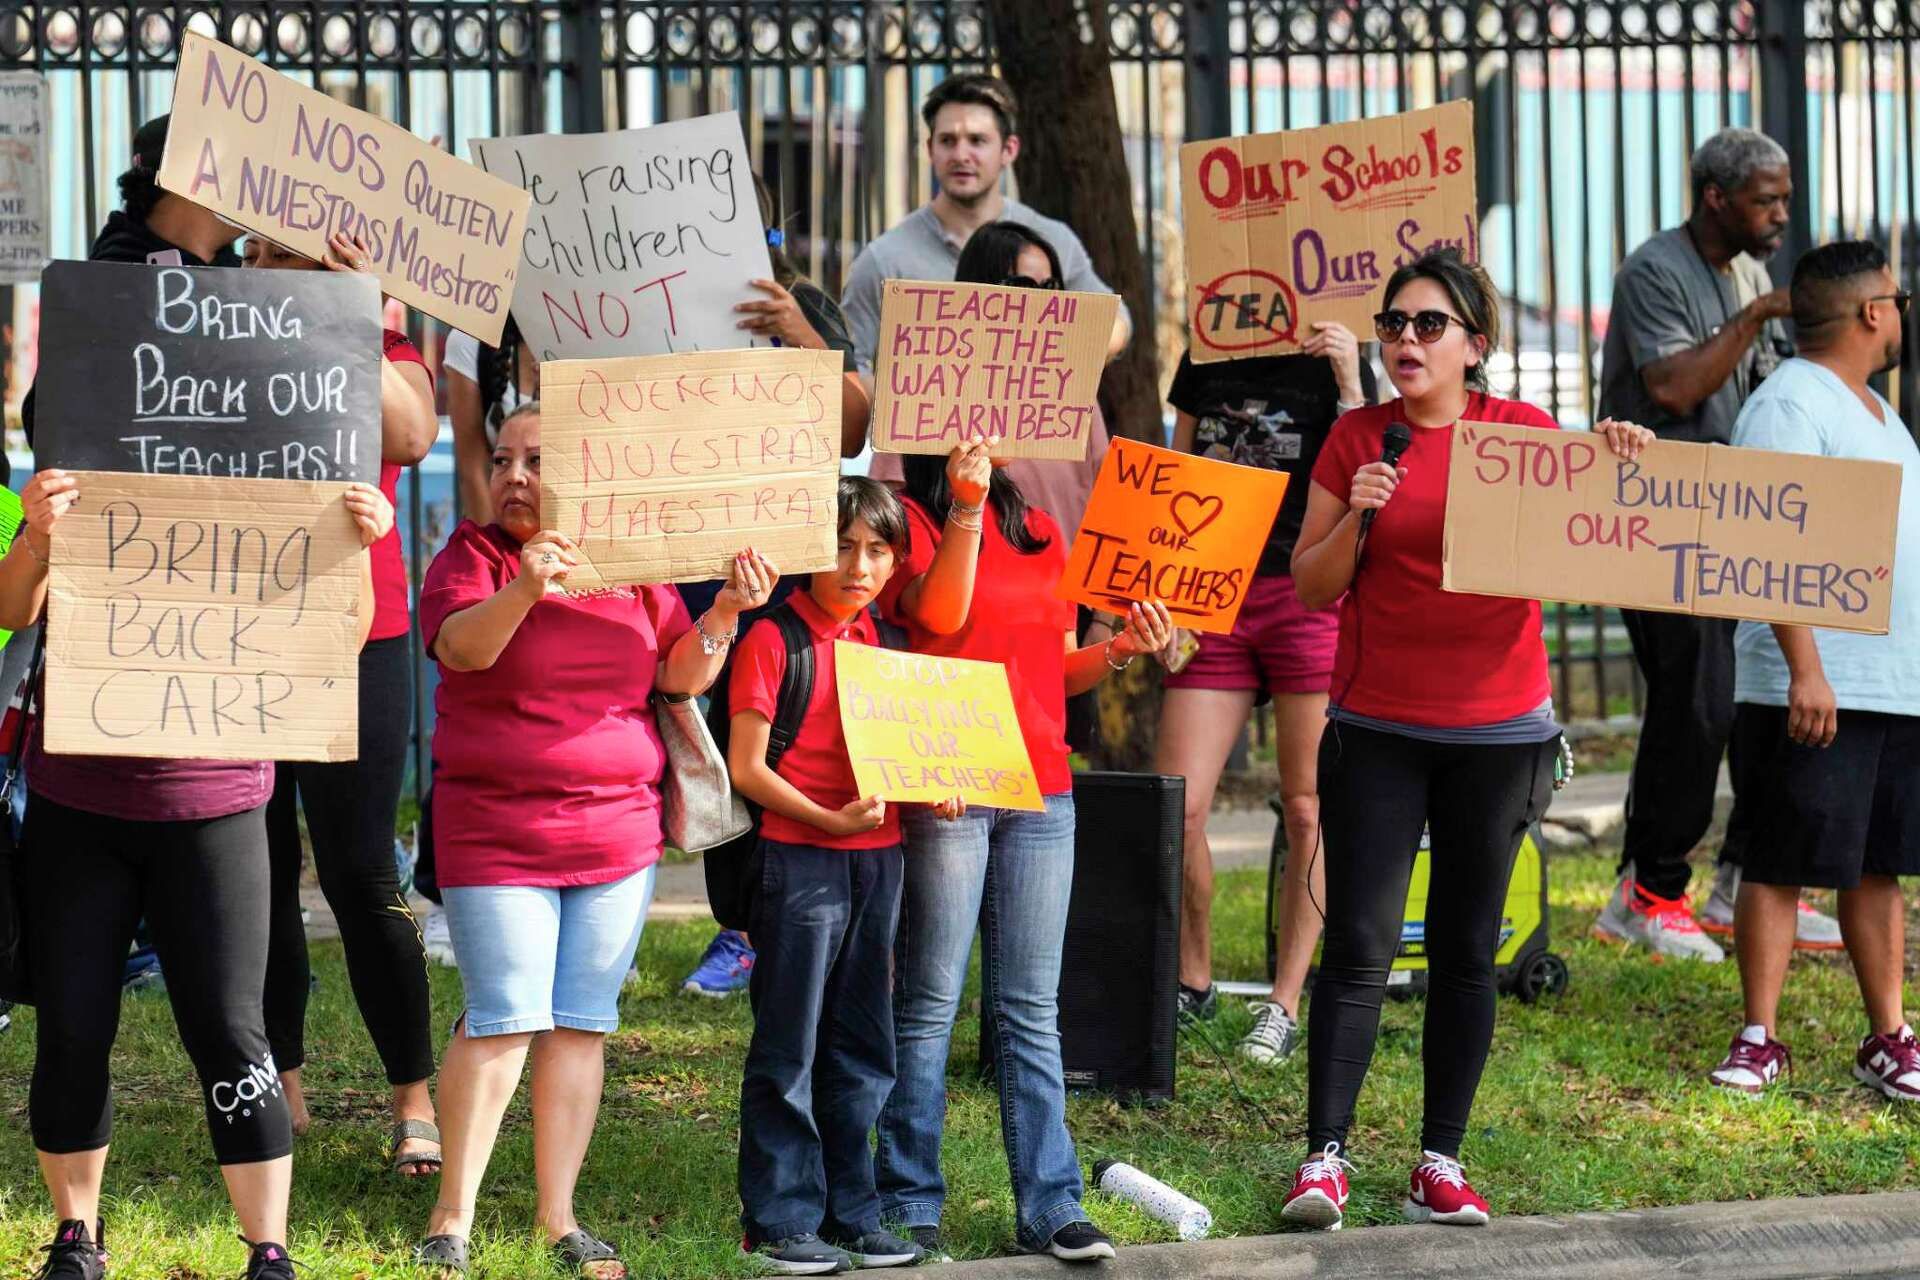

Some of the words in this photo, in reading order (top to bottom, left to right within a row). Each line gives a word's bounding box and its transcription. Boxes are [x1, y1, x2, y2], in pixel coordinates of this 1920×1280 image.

[292, 104, 385, 192] NOS
[404, 160, 513, 247] QUITEN
[578, 149, 736, 222] raising
[1320, 127, 1463, 202] Schools
[190, 138, 222, 200] A
[237, 157, 387, 264] NUESTRAS
[522, 205, 731, 277] children
[156, 268, 302, 340] BRING
[543, 270, 686, 343] NOT
[1202, 291, 1291, 332] TEA
[133, 342, 248, 416] BACK
[267, 366, 348, 417] OUR
[893, 324, 975, 358] KIDS
[985, 327, 1065, 364] THE
[578, 370, 825, 423] QUEREMOS
[891, 362, 970, 397] WAY
[982, 364, 1073, 400] THEY
[119, 429, 357, 480] TEACHERS!!
[890, 401, 1008, 441] LEARN
[581, 427, 833, 488] NUESTRAS
[1462, 427, 1596, 493] "STOP
[1613, 461, 1808, 534] BULLYING
[1081, 528, 1243, 609] TEACHERS
[1566, 513, 1658, 551] OUR
[1658, 542, 1890, 613] TEACHERS"
